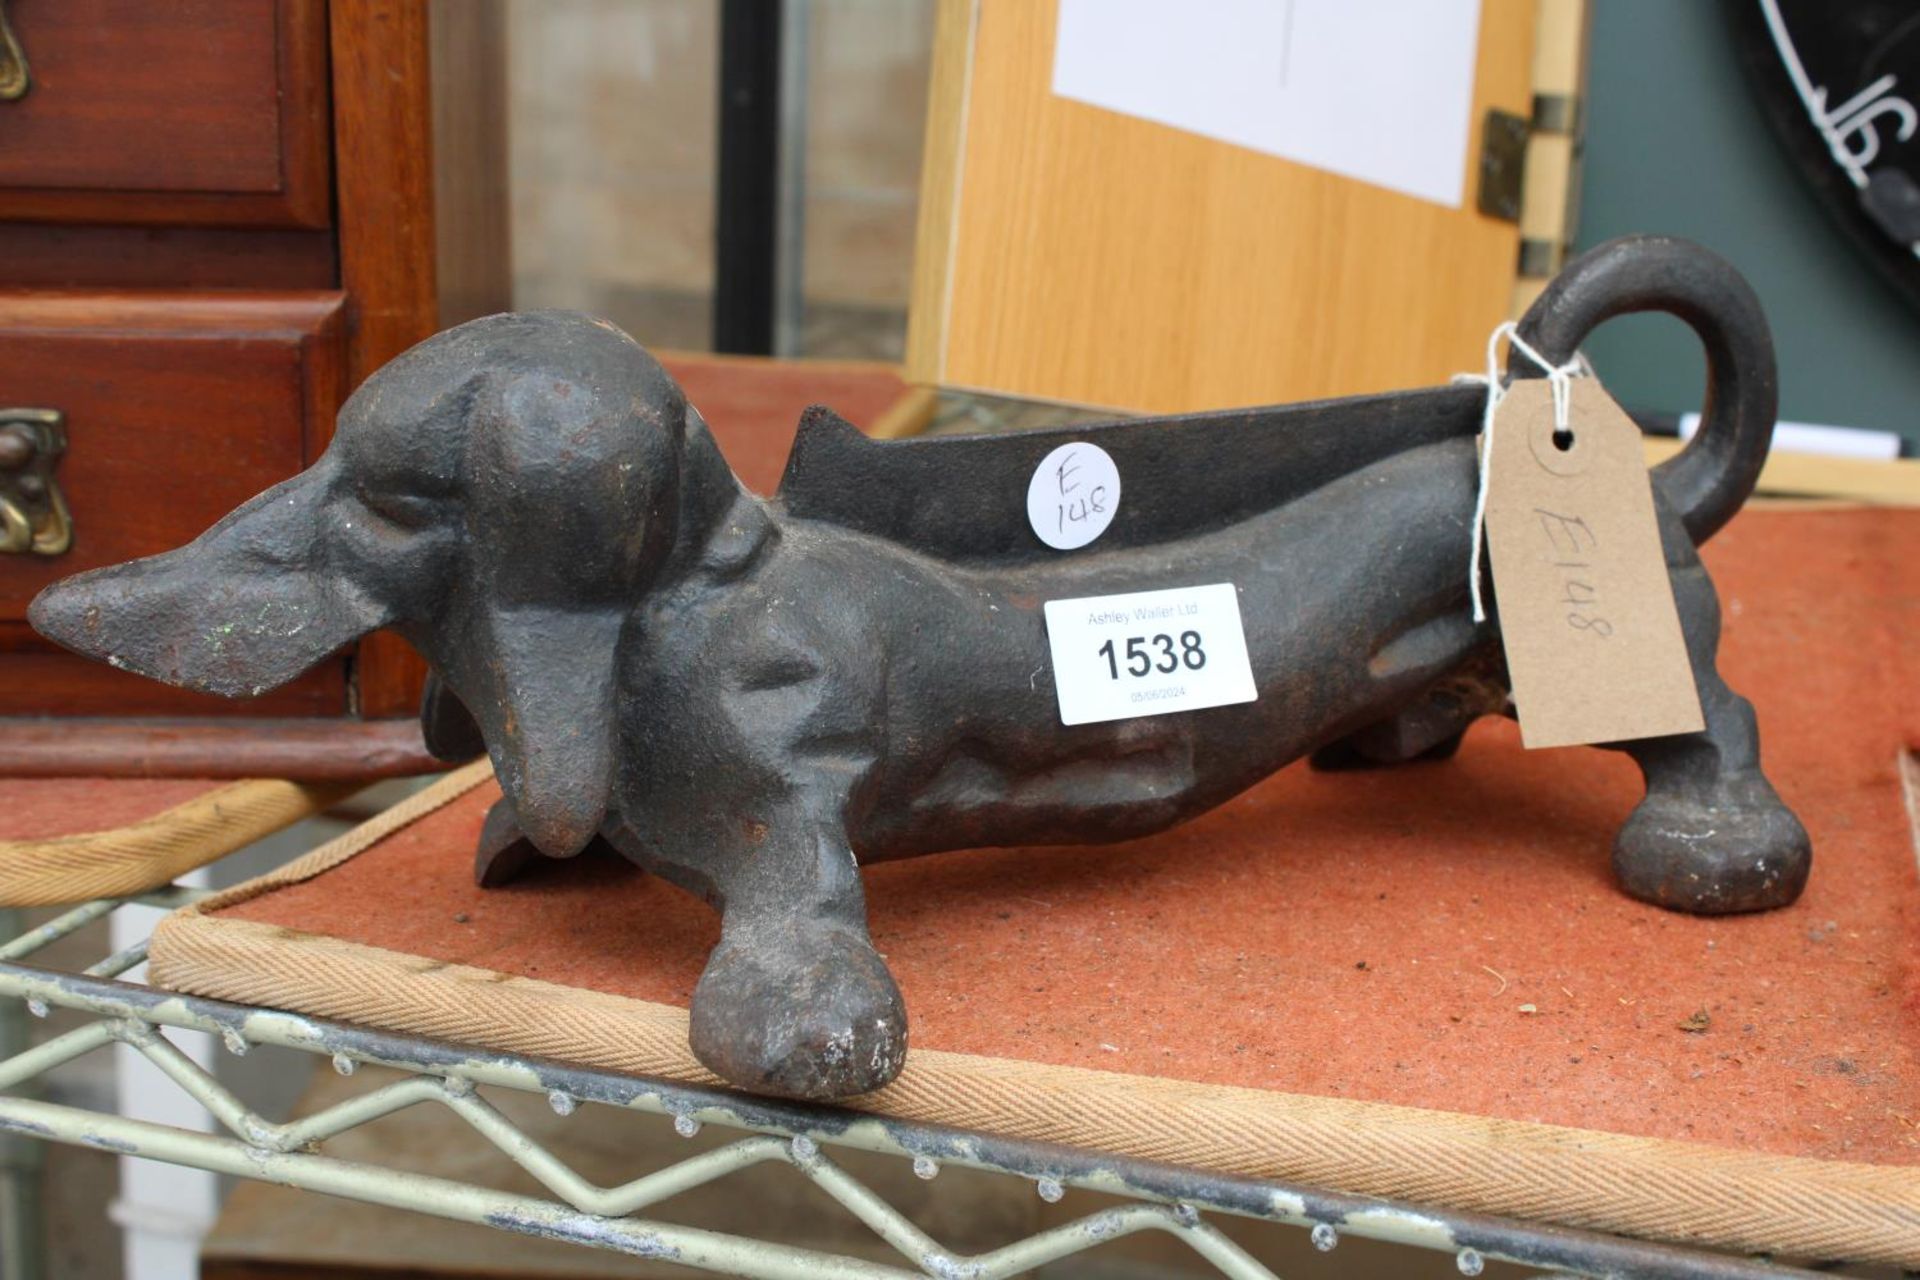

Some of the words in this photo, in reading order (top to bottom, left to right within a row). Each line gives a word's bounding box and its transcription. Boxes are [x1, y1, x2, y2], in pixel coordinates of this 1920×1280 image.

[1056, 451, 1082, 497] E
[1057, 486, 1106, 534] 148
[1533, 507, 1614, 640] E148
[1088, 610, 1131, 626] Ashley
[1134, 605, 1174, 621] Waller
[1178, 602, 1199, 617] Ltd
[1098, 630, 1207, 681] 1538
[1130, 686, 1187, 704] 05/06/2024
